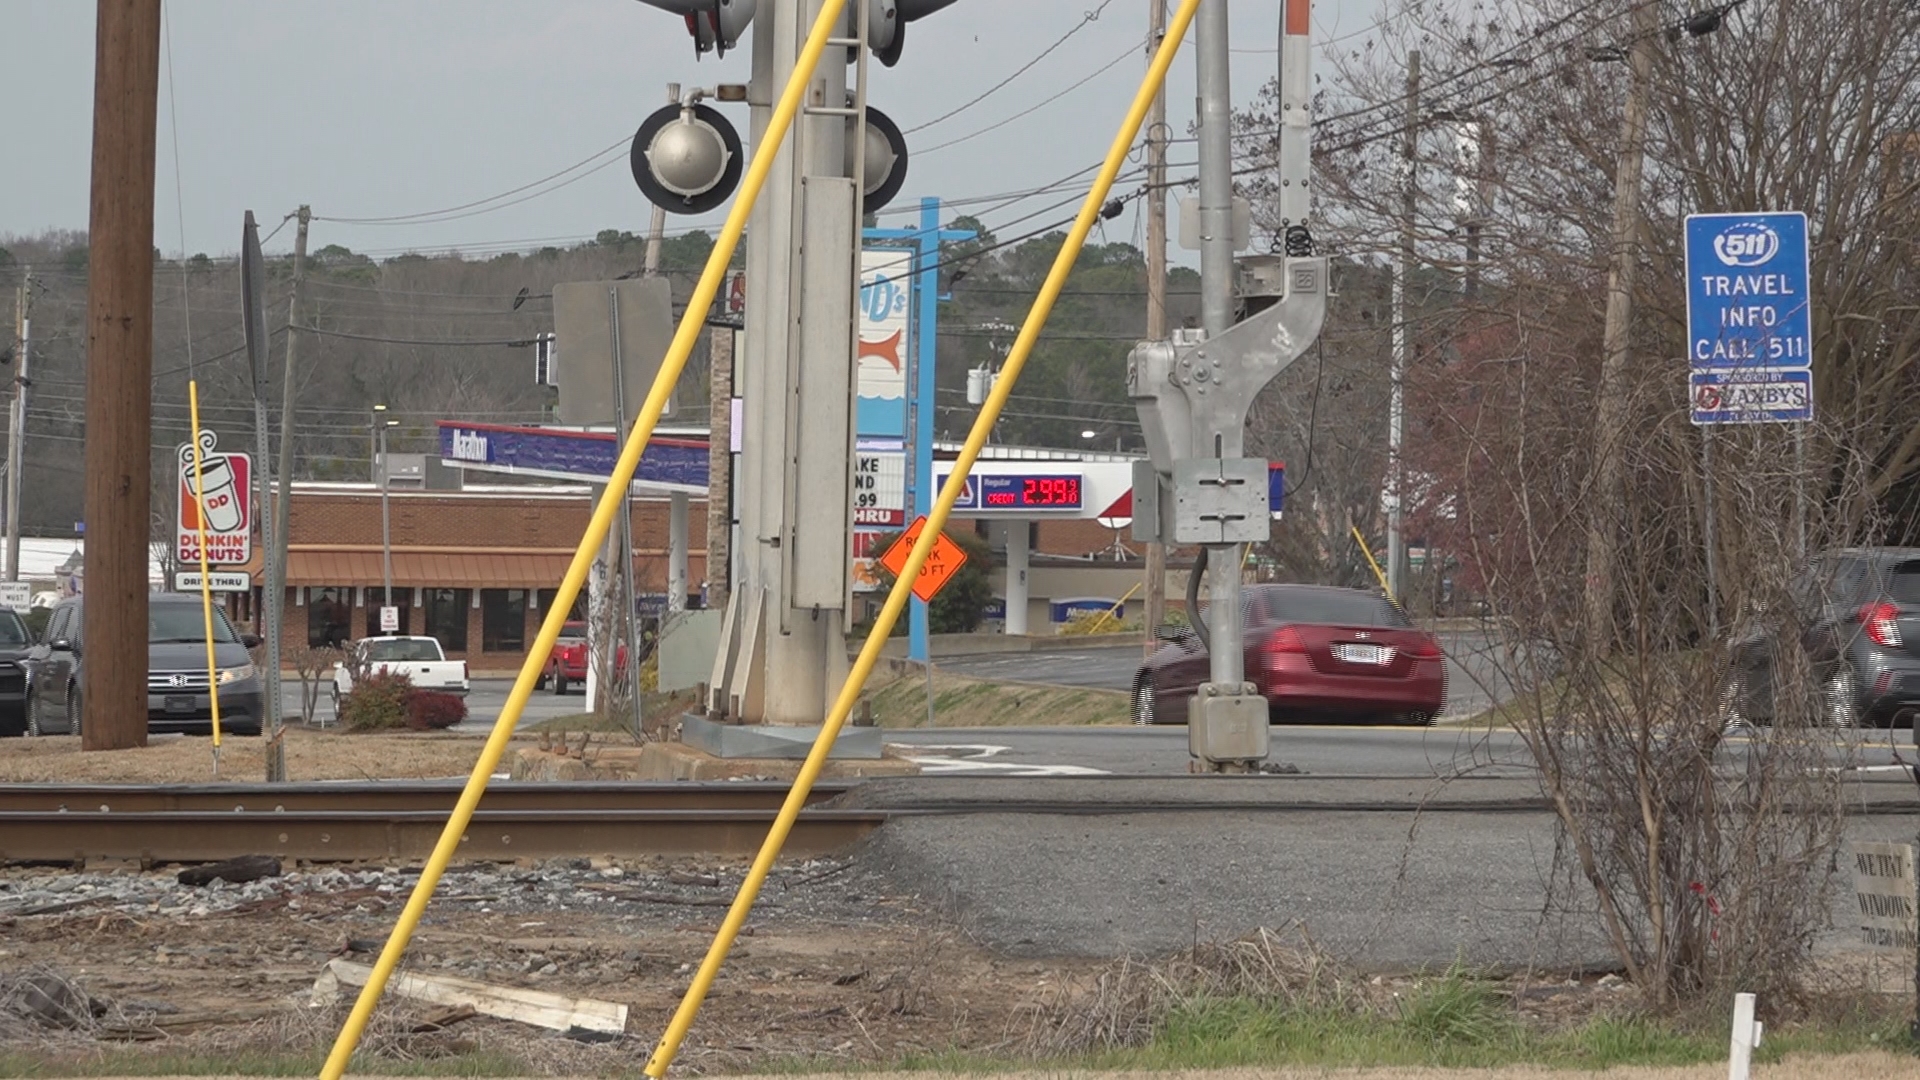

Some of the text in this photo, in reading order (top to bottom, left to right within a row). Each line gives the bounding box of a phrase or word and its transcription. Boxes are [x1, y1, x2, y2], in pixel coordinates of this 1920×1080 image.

[1726, 234, 1766, 256] 511
[1702, 274, 1794, 296] TRAVEL
[1721, 306, 1776, 327] INFO
[1696, 337, 1803, 360] CALL 511
[452, 428, 488, 462] Marathon
[207, 494, 229, 509] DD
[987, 493, 1016, 504] CREDIT
[180, 548, 244, 561] DONUTS
[931, 565, 945, 575] FT
[216, 578, 242, 586] THRU
[1856, 853, 1903, 878] WE TINT
[1857, 893, 1912, 919] WINDOWS
